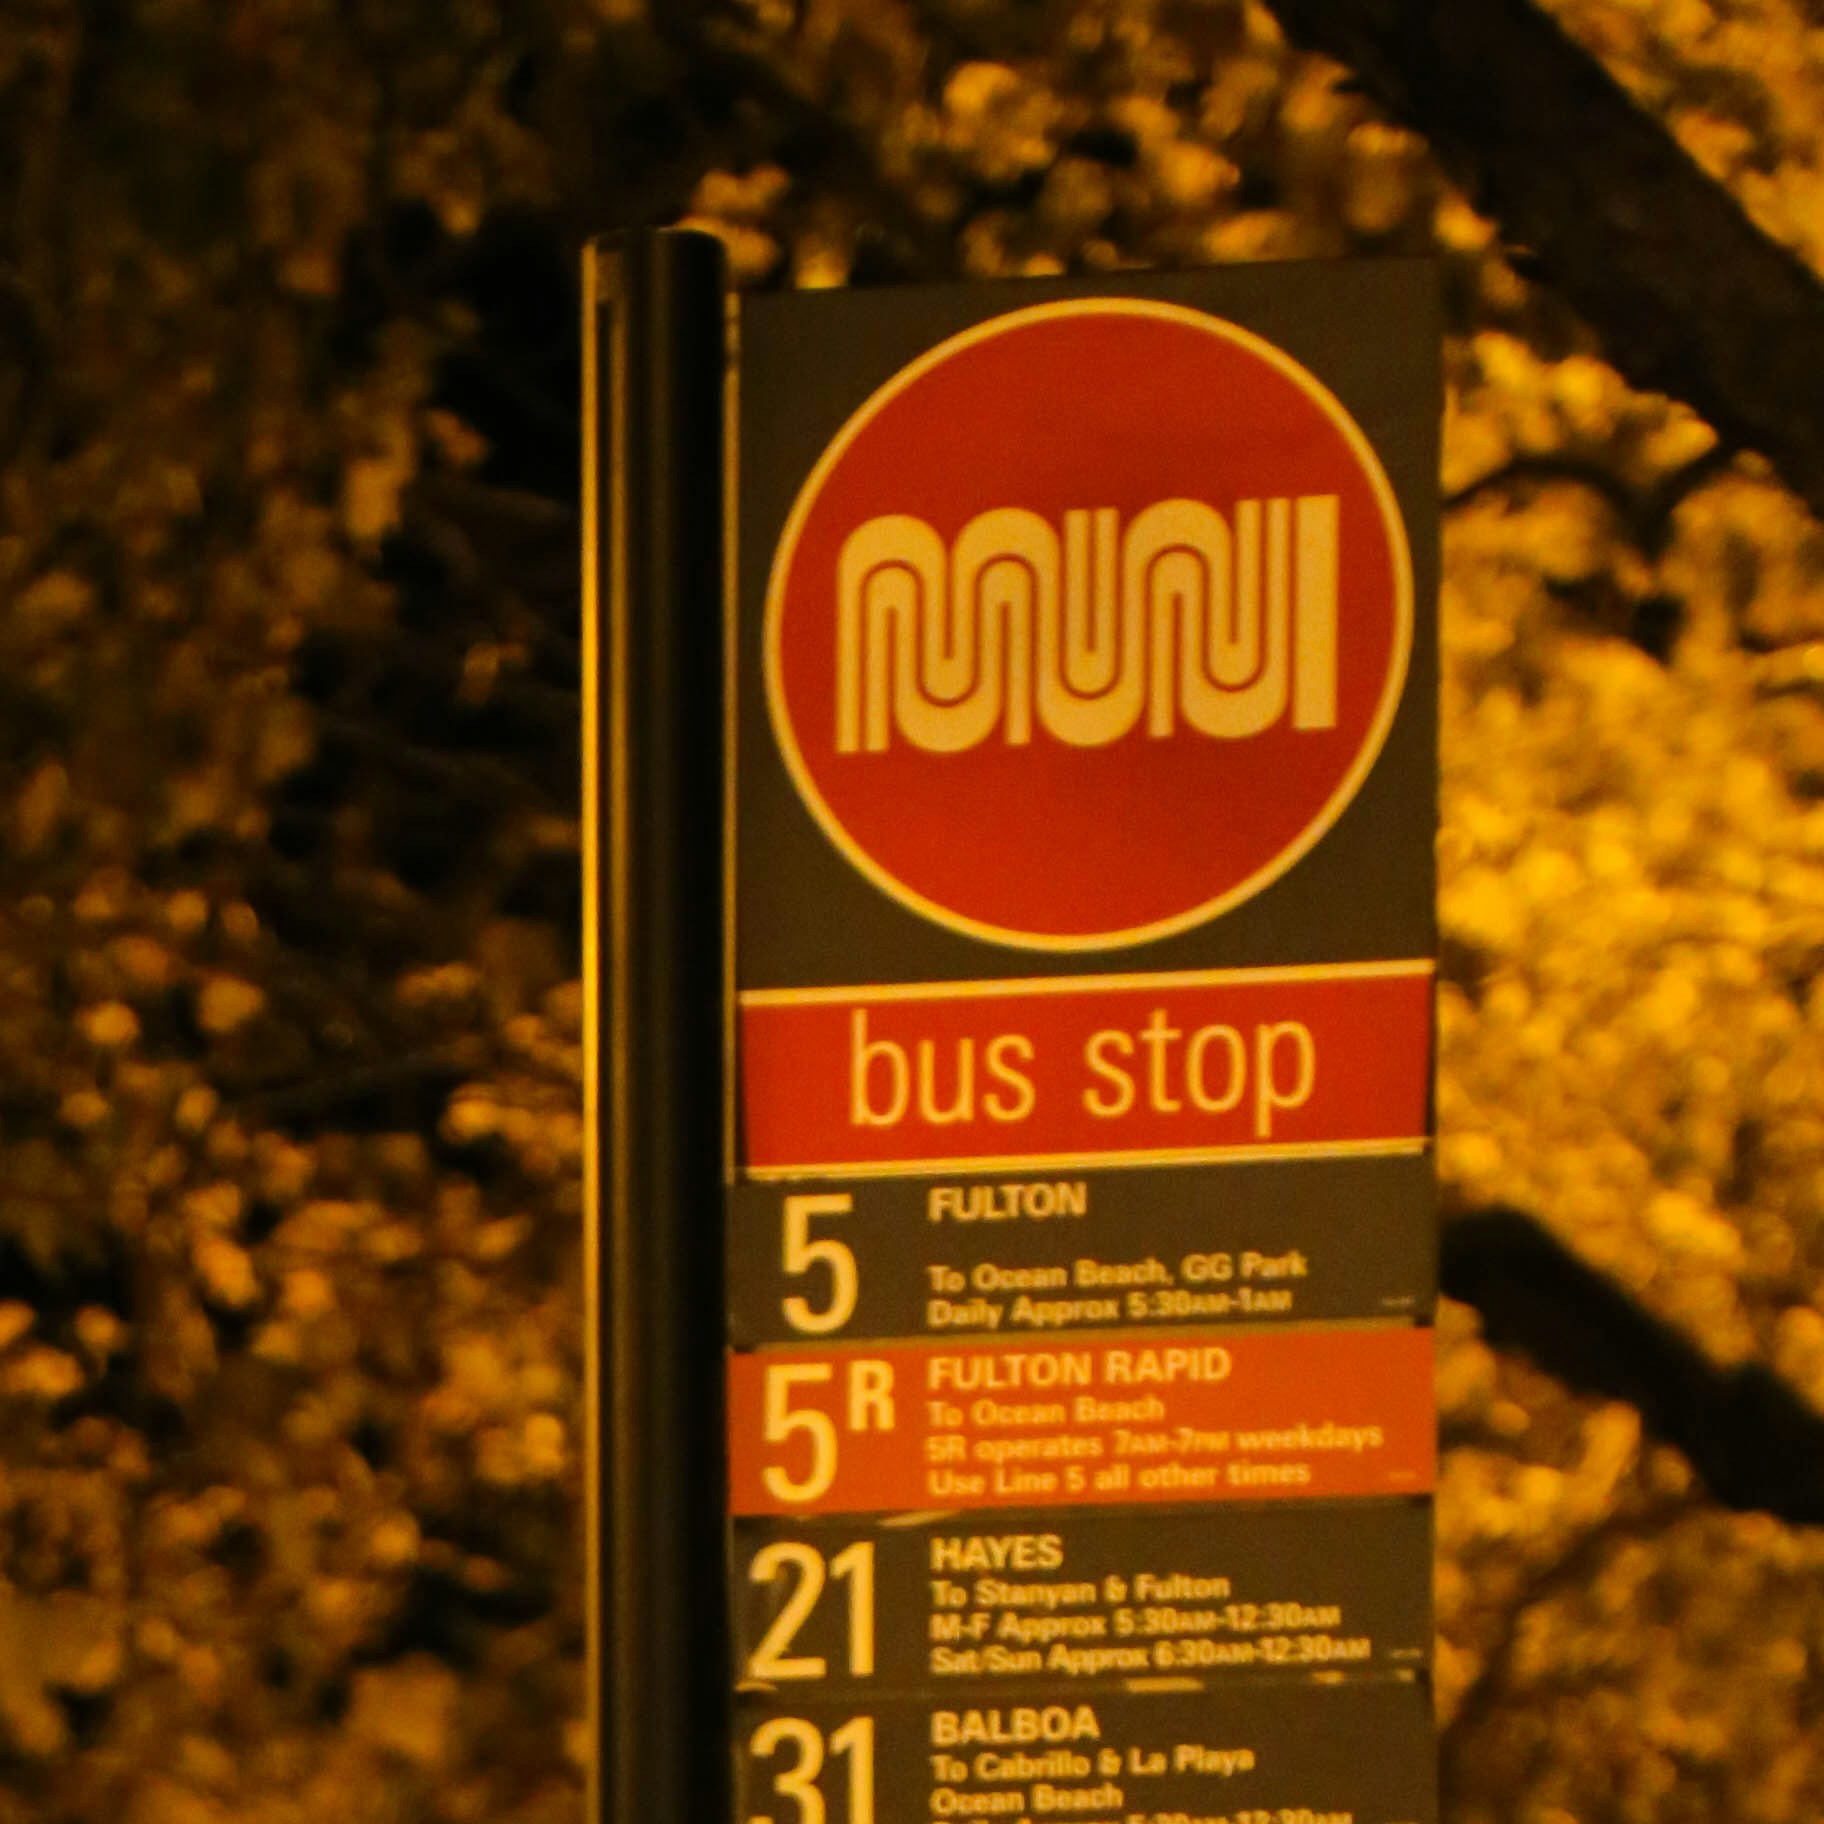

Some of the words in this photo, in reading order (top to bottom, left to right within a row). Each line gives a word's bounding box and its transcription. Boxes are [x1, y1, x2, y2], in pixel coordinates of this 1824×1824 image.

[849, 1008, 1036, 1130] bus
[1082, 1008, 1315, 1138] stop
[928, 1181, 1087, 1222] FULTON
[782, 1192, 859, 1333] 5
[927, 1266, 965, 1293] To
[974, 1262, 1067, 1291] Ocean
[1074, 1256, 1173, 1288] Beach,
[1182, 1253, 1232, 1282] GG
[1240, 1249, 1308, 1279] Park
[927, 1299, 1003, 1329] Daily
[1011, 1295, 1119, 1328] Approx
[927, 1352, 1092, 1390] FULTON
[1105, 1347, 1232, 1383] RAPID
[927, 1401, 963, 1426] To
[972, 1399, 1066, 1425] Ocean
[1074, 1394, 1165, 1422] Beach
[976, 1434, 1103, 1463] operates
[1236, 1422, 1382, 1453] weekdays
[927, 1470, 983, 1496] Use
[995, 1467, 1056, 1494] Line
[1065, 1466, 1085, 1493] 5
[1095, 1463, 1129, 1491] all
[1139, 1463, 1217, 1490] other
[1227, 1459, 1311, 1486] times
[930, 1534, 1063, 1571] HAYES
[748, 1538, 876, 1680] 21
[929, 1580, 967, 1607] To
[976, 1579, 1096, 1609] Stanyan
[1105, 1576, 1127, 1601] &
[1135, 1573, 1230, 1600] Fulton
[929, 1613, 990, 1640] M-F
[997, 1611, 1106, 1643] Approx
[1048, 1644, 1149, 1675] Approx
[931, 1705, 1100, 1746] BALBOA
[930, 1755, 968, 1783] To
[978, 1751, 1091, 1780] Cabrillo
[1098, 1749, 1121, 1776] &
[1129, 1748, 1166, 1775] La
[1176, 1745, 1256, 1776] Playa
[931, 1789, 1025, 1815] Ocean
[1032, 1783, 1123, 1812] Beach
